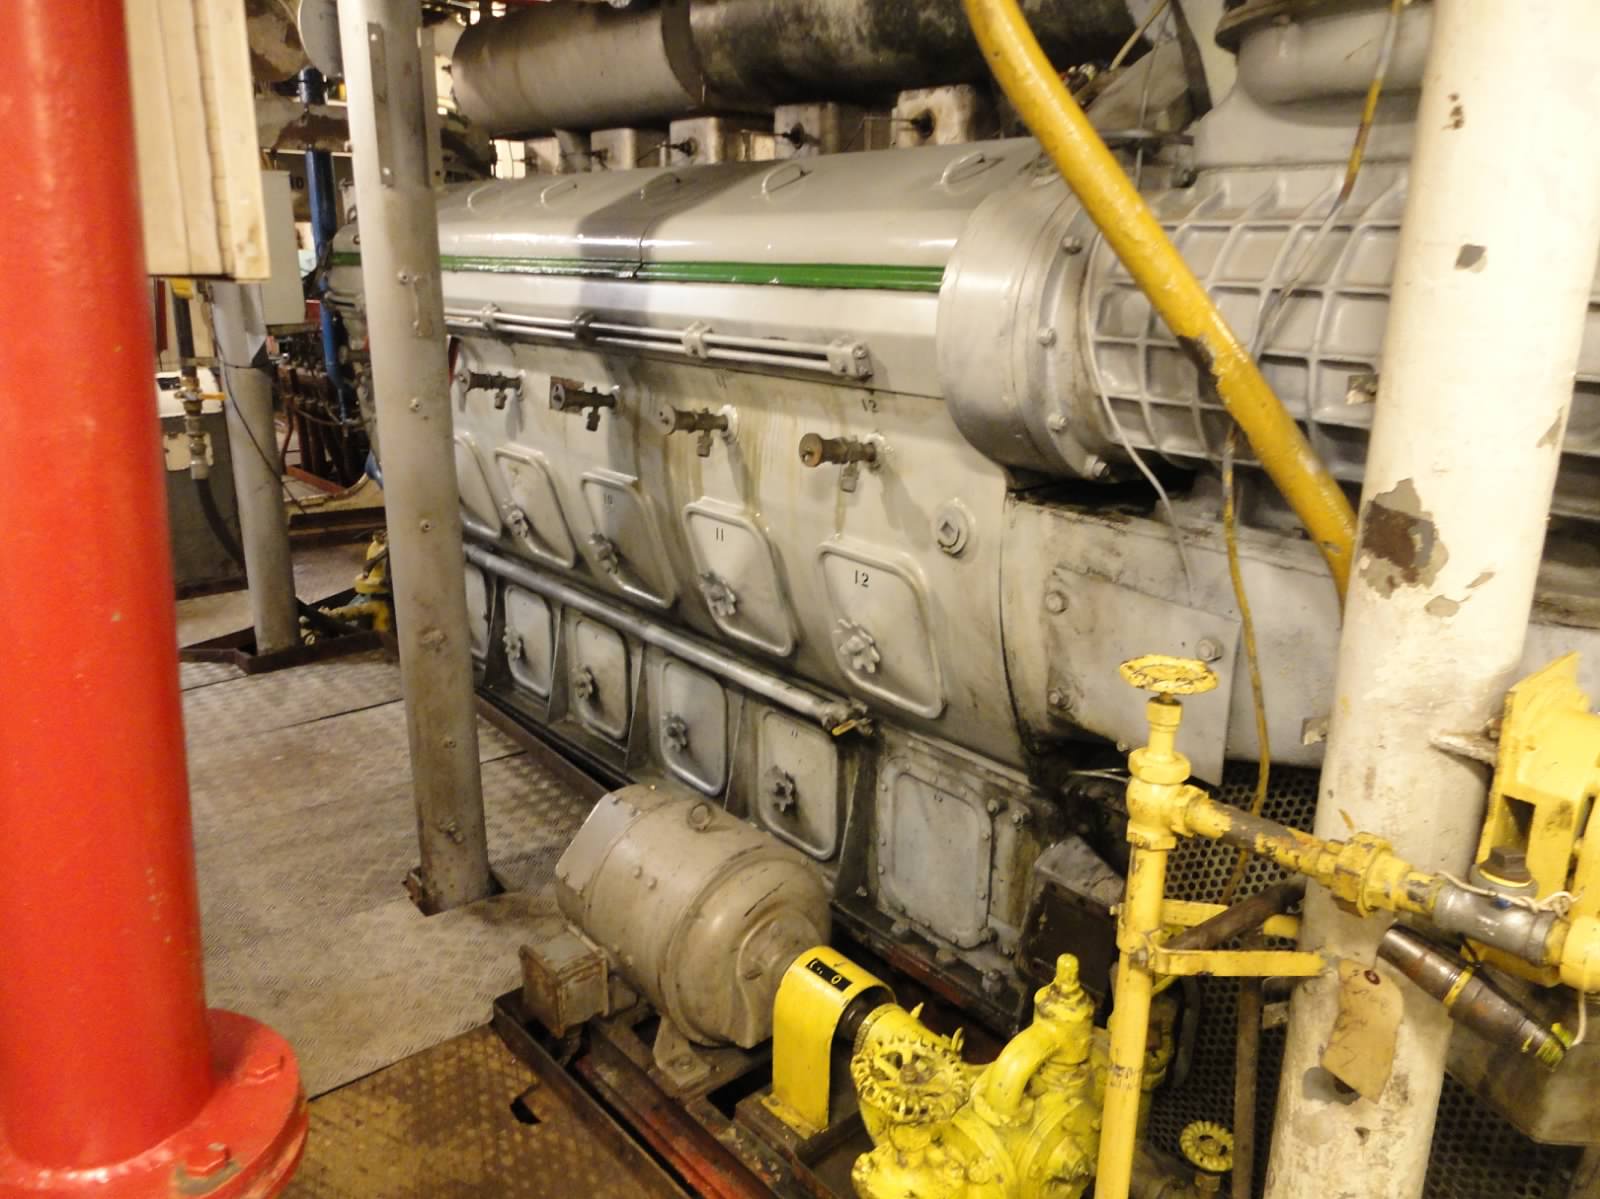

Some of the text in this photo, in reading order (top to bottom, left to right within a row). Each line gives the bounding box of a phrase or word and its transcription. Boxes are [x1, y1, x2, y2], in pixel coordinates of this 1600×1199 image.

[862, 399, 880, 414] 12
[715, 527, 724, 542] 11
[854, 570, 870, 588] 12
